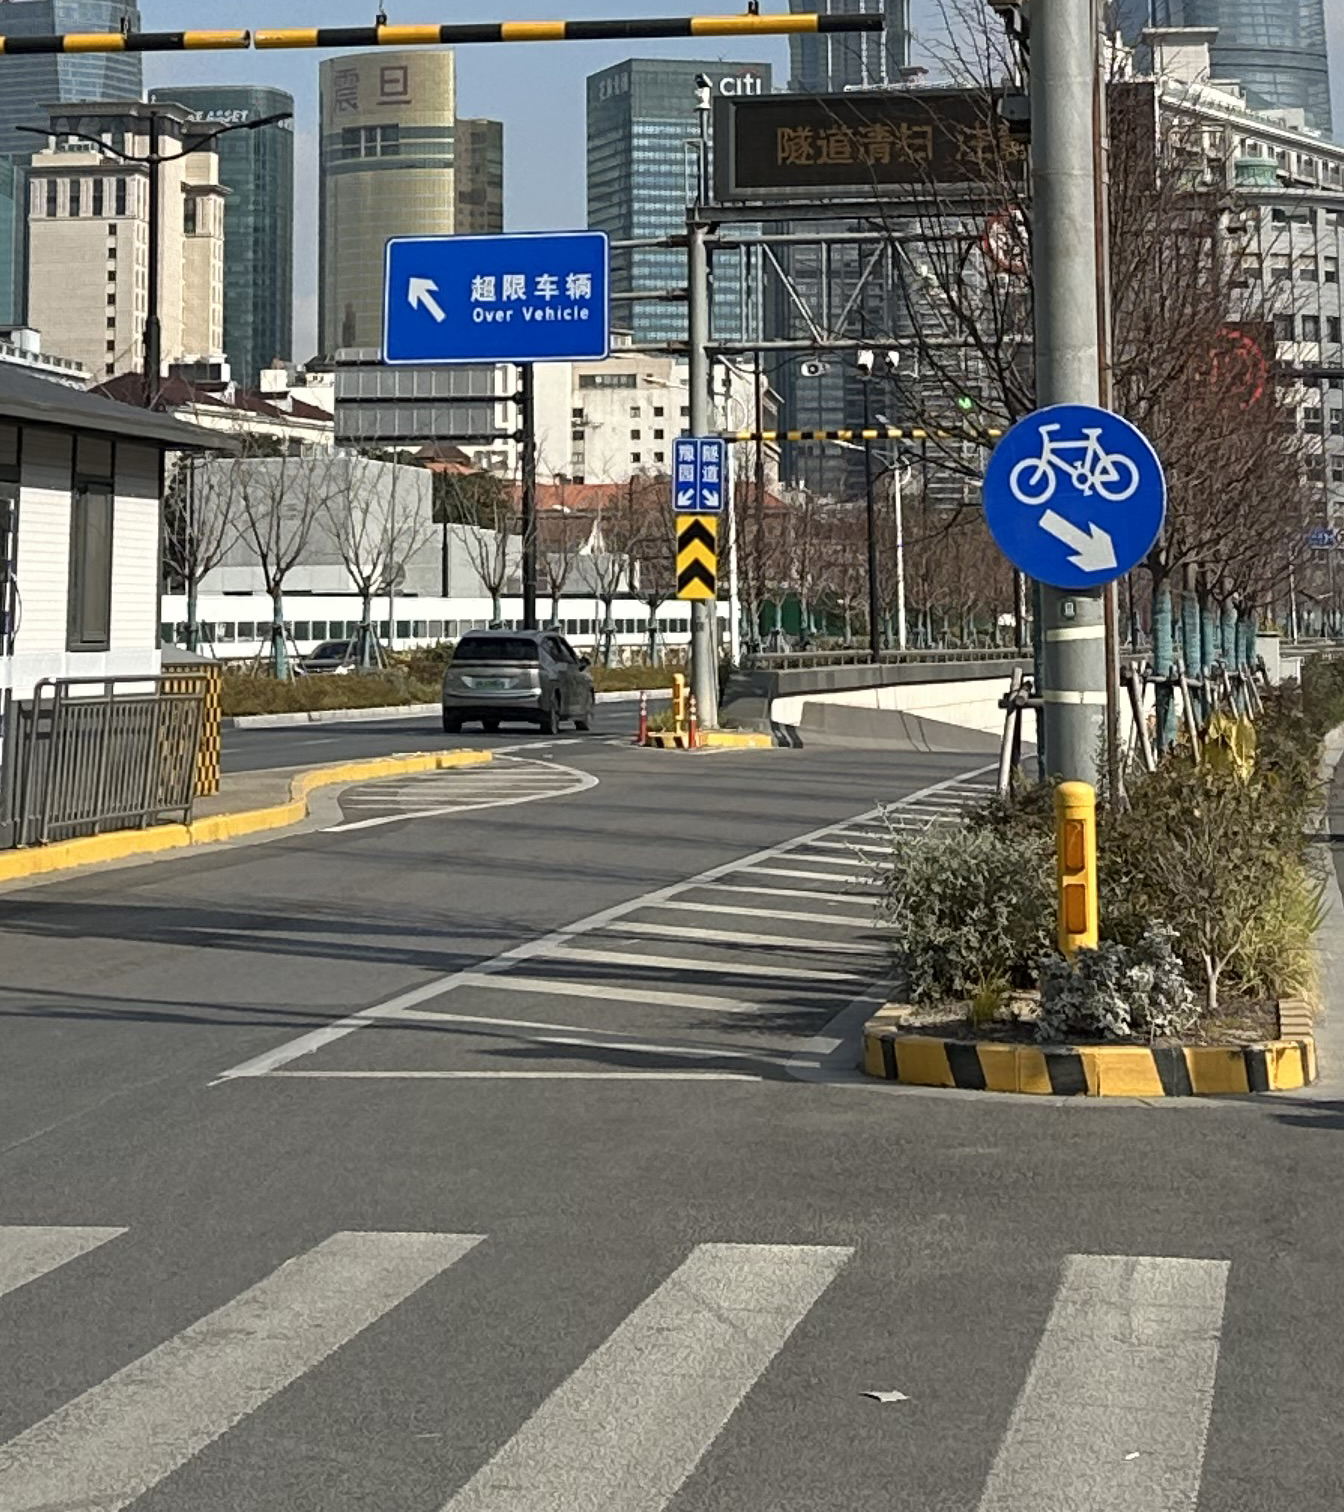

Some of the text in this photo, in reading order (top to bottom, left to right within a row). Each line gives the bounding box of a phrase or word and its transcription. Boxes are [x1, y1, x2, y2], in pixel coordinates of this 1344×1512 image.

[470, 273, 592, 302] 超限车辆
[473, 306, 589, 323] Over Vehicle
